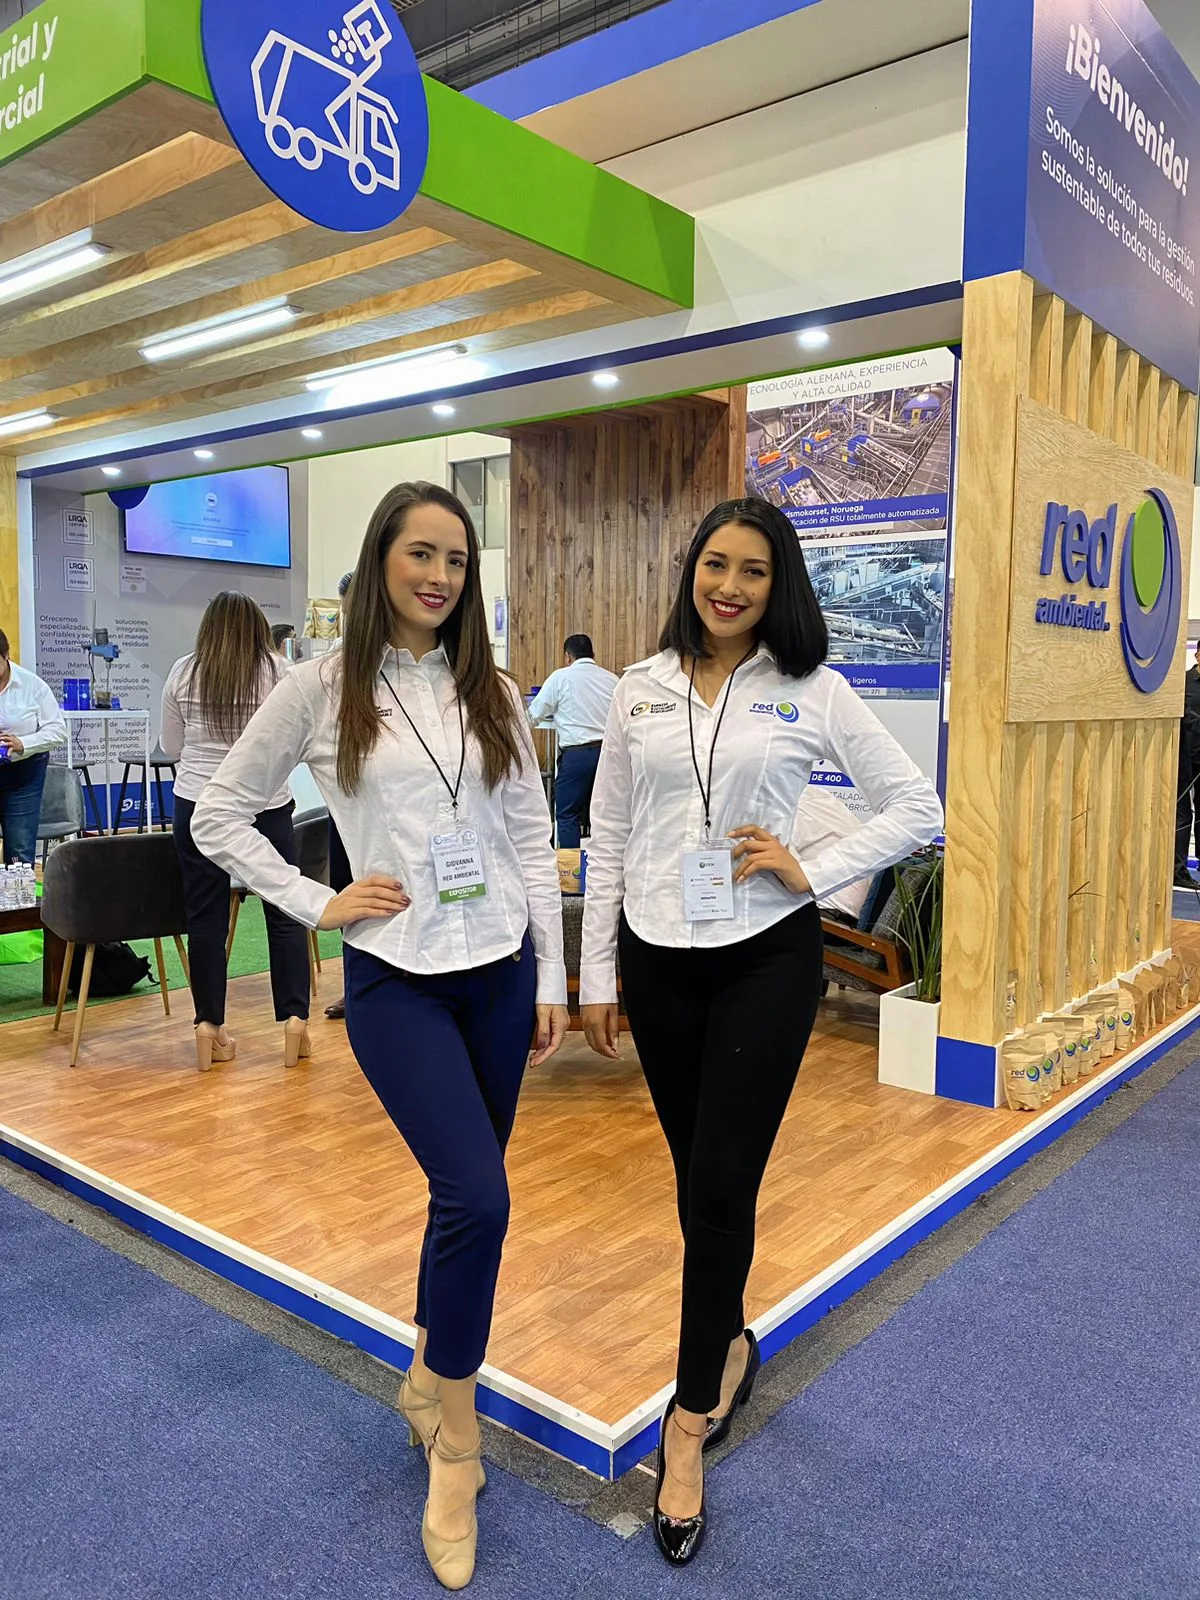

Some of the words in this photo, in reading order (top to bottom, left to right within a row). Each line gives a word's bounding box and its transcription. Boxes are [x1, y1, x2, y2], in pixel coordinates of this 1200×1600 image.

[0, 21, 38, 80] rial
[42, 15, 59, 61] y
[1065, 23, 1189, 197] ¡Bienvenido!
[1046, 105, 1084, 165] Somos
[1086, 146, 1095, 177] la
[1097, 164, 1137, 219] solución
[1139, 207, 1157, 240] para
[1159, 221, 1166, 246] la
[1167, 235, 1195, 277] gestión
[1041, 150, 1105, 225] sustentable
[1107, 210, 1120, 238] de
[1122, 224, 1147, 260] todos
[1148, 247, 1161, 275] tus
[1162, 264, 1195, 307] residuos.
[749, 379, 804, 395] ECNOLOGÍA
[807, 370, 857, 386] ALEMANA,
[860, 358, 928, 377] EXPERIENCIA
[792, 391, 799, 399] Y
[802, 387, 825, 398] ALTA
[827, 379, 872, 394] CALIDAD
[785, 507, 830, 518] dsmokorset,
[831, 504, 864, 515] Noruega
[819, 516, 829, 524] de
[830, 515, 845, 523] RSU
[846, 511, 886, 521] totalmente
[887, 506, 940, 518] automatizada
[68, 514, 88, 523] LRQA
[1039, 501, 1118, 589] red
[69, 562, 89, 570] LRQA
[68, 661, 89, 669] (Mane
[852, 676, 877, 685] ligeros
[752, 702, 774, 711] red
[811, 773, 824, 781] DE
[825, 774, 842, 782] 400
[830, 791, 864, 801] TALAD
[845, 803, 872, 812] BRIC
[445, 857, 475, 868] GIOVANNA
[442, 874, 453, 882] RED
[454, 869, 481, 880] AMBIENTAL
[448, 885, 477, 897] EXPOSITOR
[1010, 1068, 1026, 1076] red
